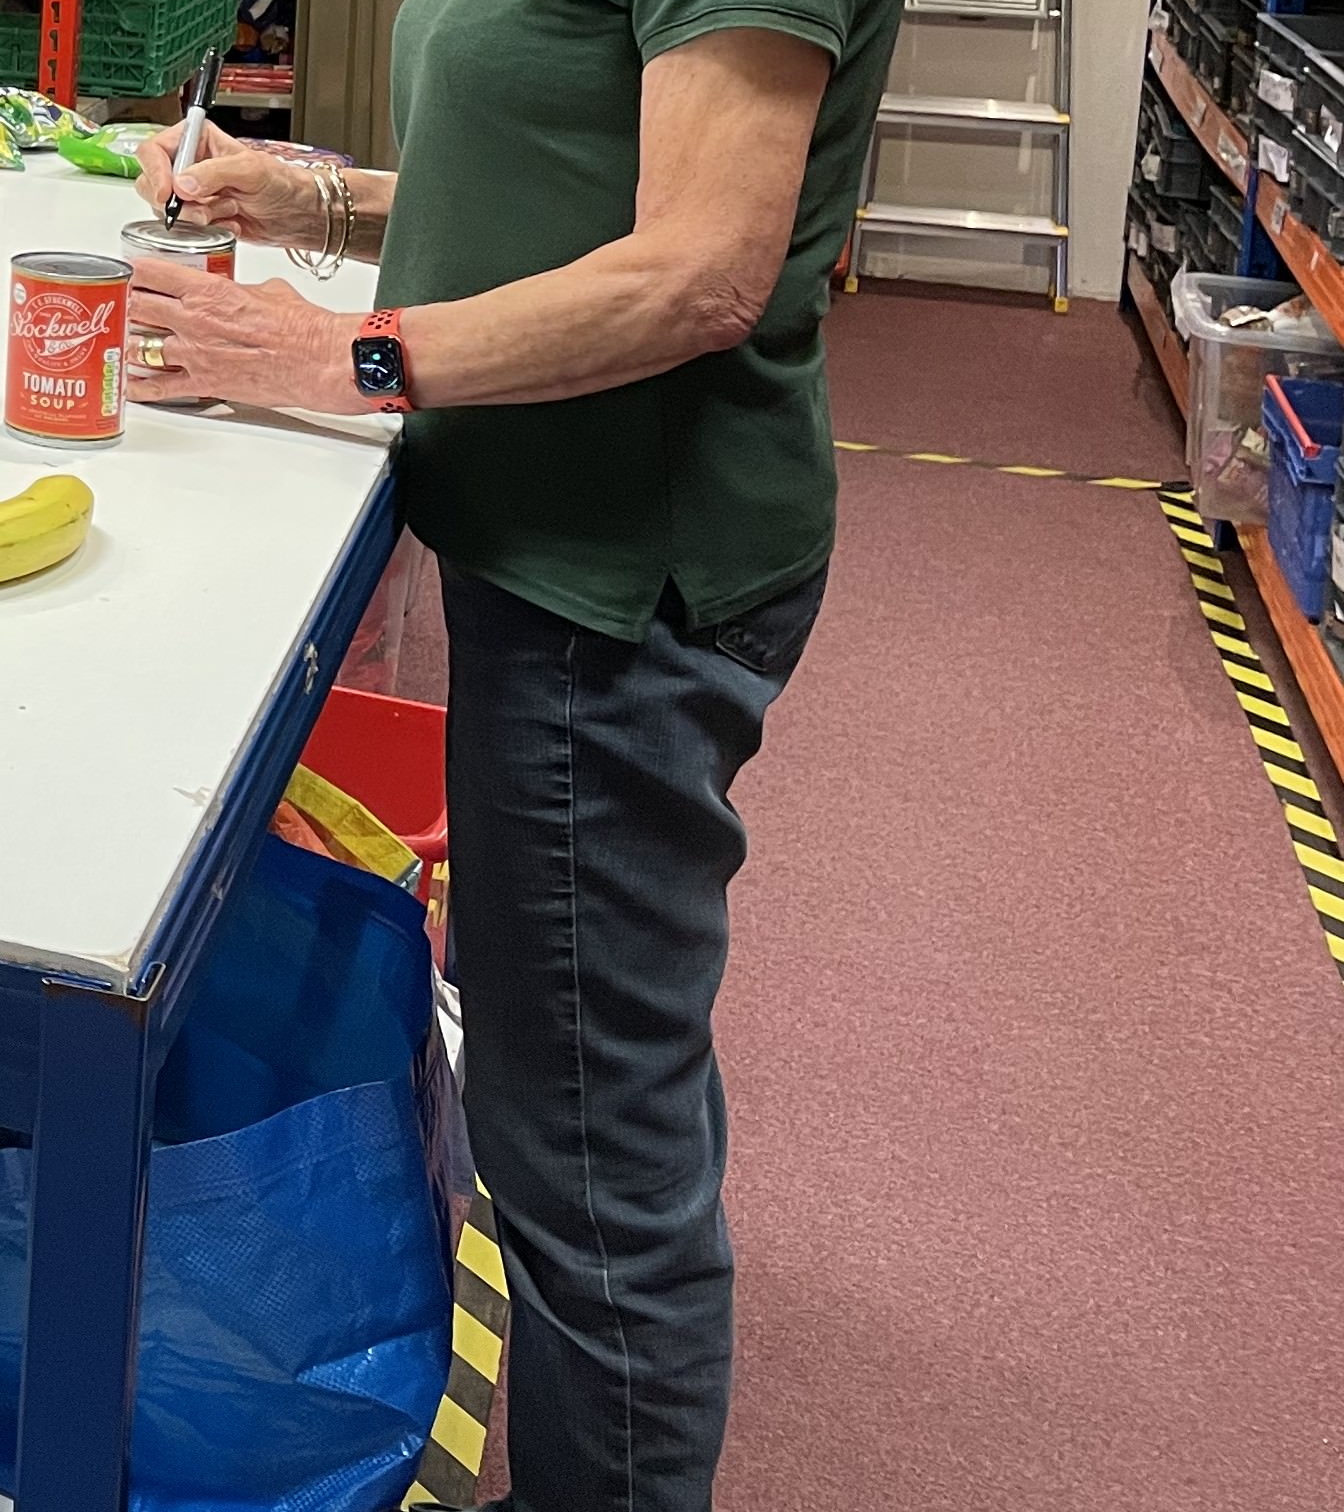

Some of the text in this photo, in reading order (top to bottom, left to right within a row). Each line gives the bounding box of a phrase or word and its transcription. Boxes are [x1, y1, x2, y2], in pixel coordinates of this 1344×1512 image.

[11, 301, 116, 338] Stockwell
[23, 371, 86, 398] TOMATO
[30, 394, 75, 410] SOUP
